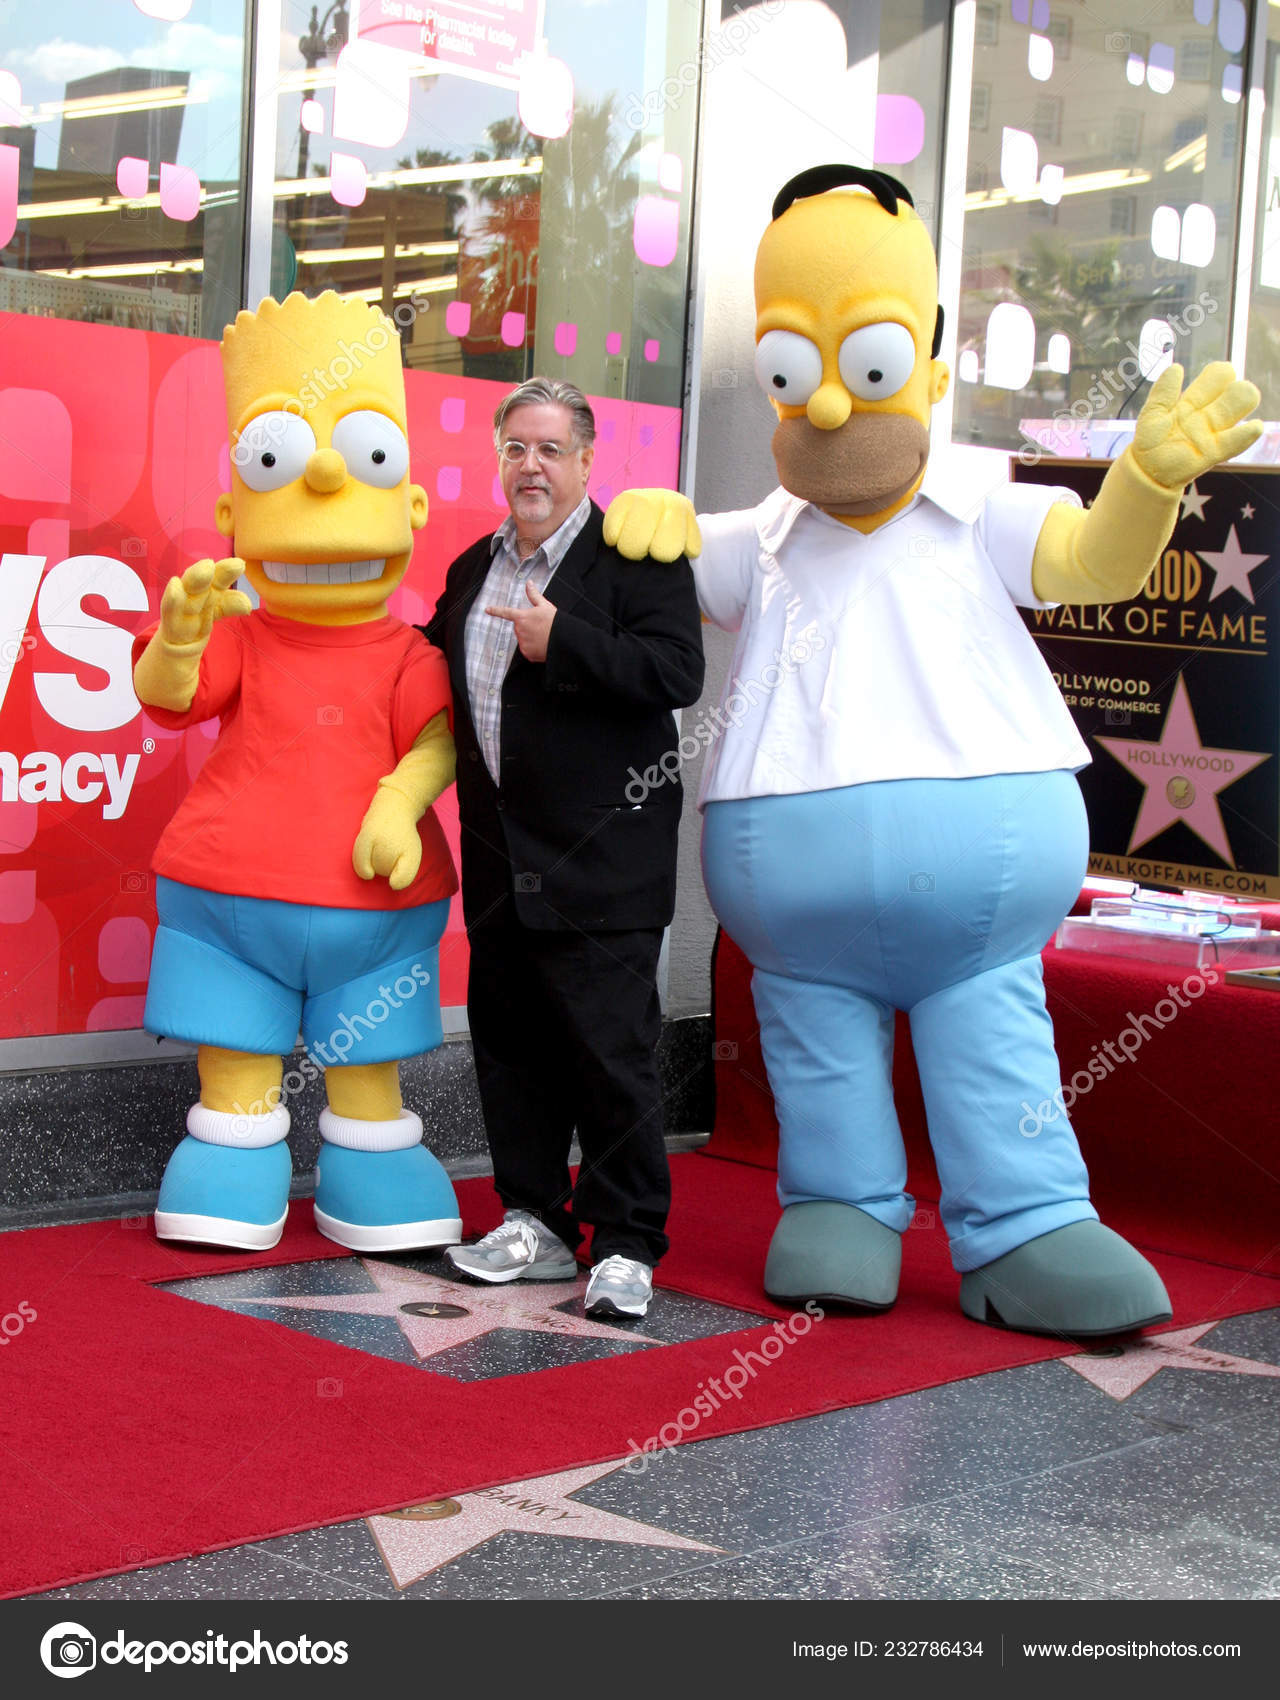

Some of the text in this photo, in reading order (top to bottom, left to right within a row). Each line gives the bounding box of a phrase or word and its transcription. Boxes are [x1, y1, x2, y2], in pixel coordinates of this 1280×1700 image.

[381, 1, 402, 18] See
[404, 4, 423, 23] the
[420, 26, 436, 45] for
[1033, 604, 1268, 644] WALK OF FAME
[1080, 696, 1096, 708] OF
[1097, 698, 1161, 714] COMMERCE
[1127, 749, 1235, 773] HOLLYWOOD
